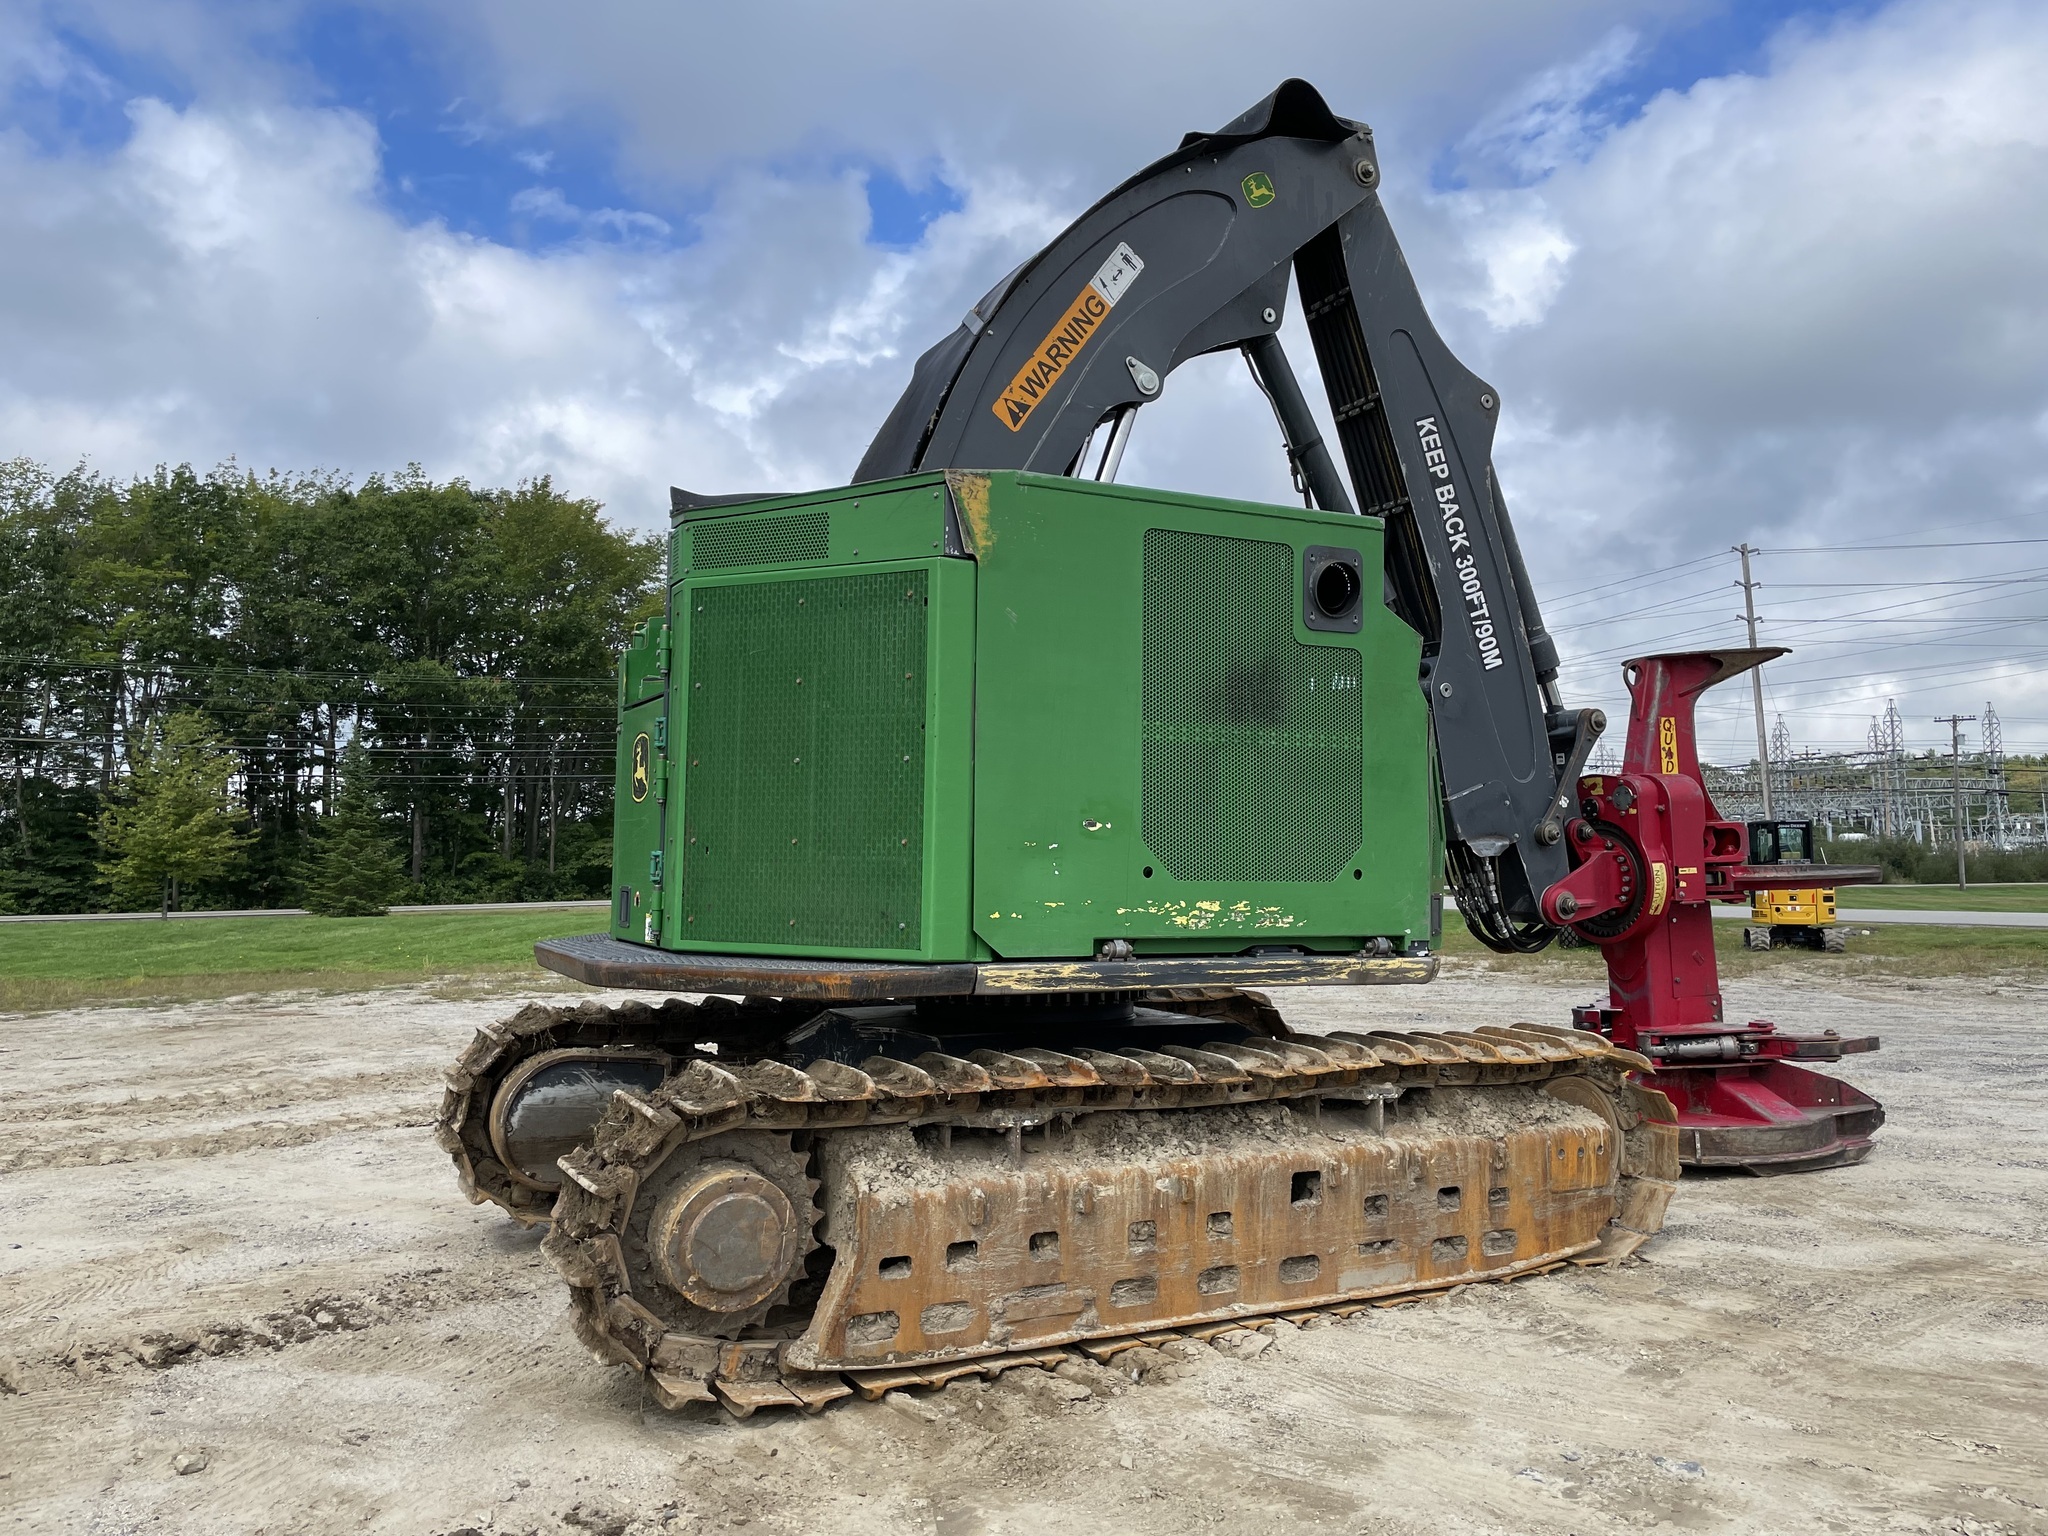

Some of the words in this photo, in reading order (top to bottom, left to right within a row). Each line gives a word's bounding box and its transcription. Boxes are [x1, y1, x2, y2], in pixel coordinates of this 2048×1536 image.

[1019, 295, 1105, 399] WARNING
[1416, 416, 1450, 479] KEEP
[1435, 483, 1470, 553] BACK
[1455, 555, 1503, 671] 300FT/90M
